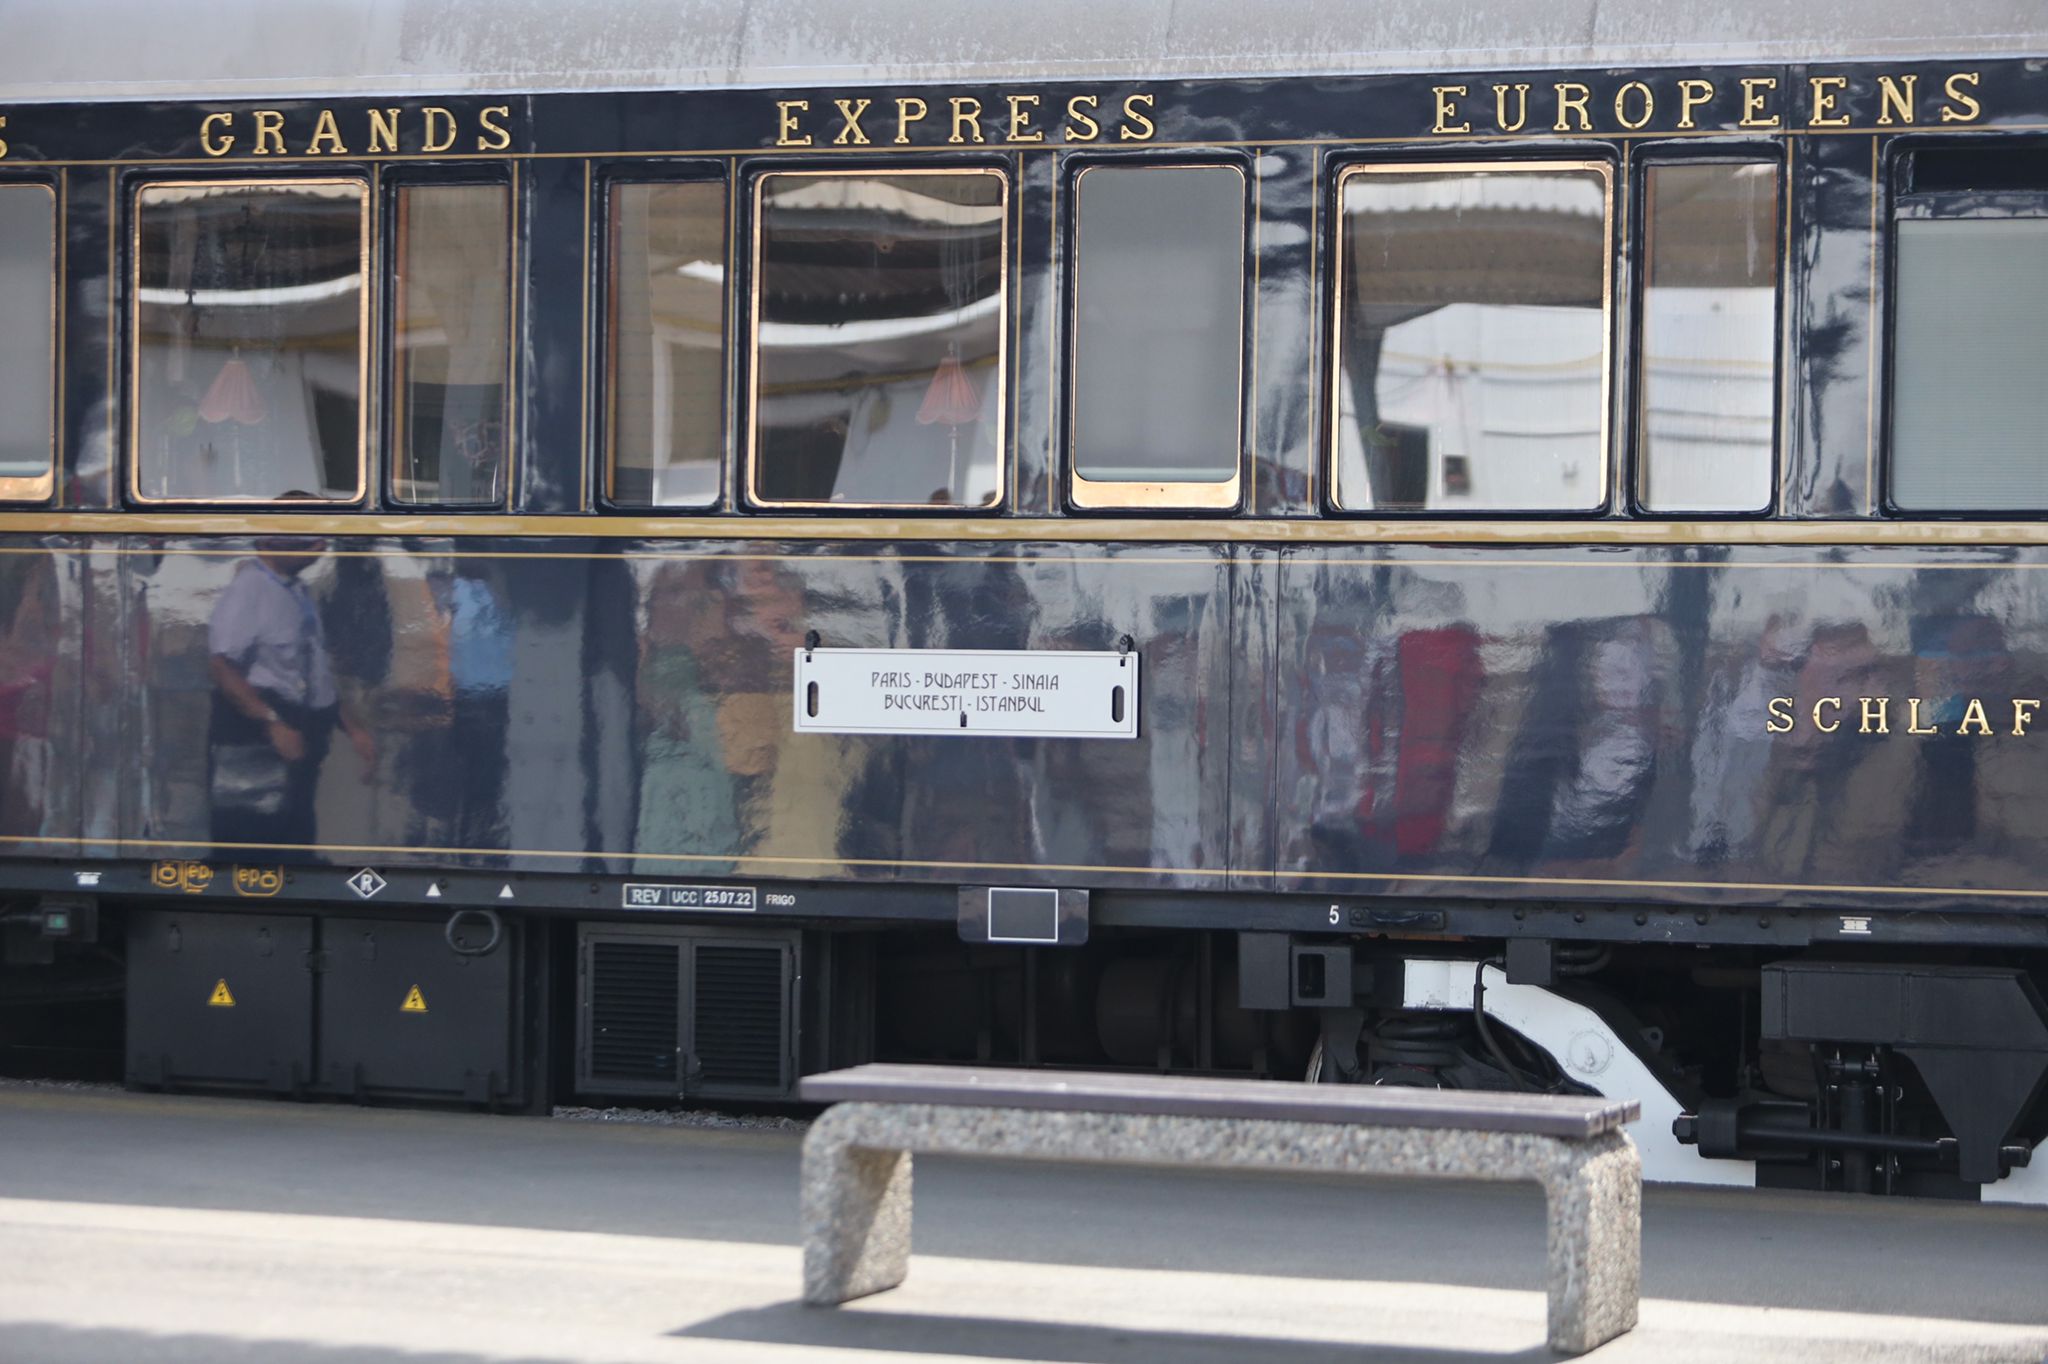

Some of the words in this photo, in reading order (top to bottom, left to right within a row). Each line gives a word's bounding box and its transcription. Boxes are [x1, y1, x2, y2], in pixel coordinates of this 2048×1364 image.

[200, 105, 513, 156] GRANDS
[775, 94, 1155, 146] EXPRESS
[1431, 72, 1982, 133] EUROPEENS
[871, 672, 911, 688] PARIS
[924, 673, 997, 689] BUDAPEST
[1011, 674, 1059, 690] SINAIA
[884, 695, 963, 711] BUCURESTI
[976, 696, 1045, 713] ISTANBUL
[1766, 697, 2041, 736] SCHLAF
[631, 889, 662, 904] REV
[672, 891, 698, 904] UCC
[766, 894, 796, 906] FRIGO
[1329, 904, 1340, 925] 5
